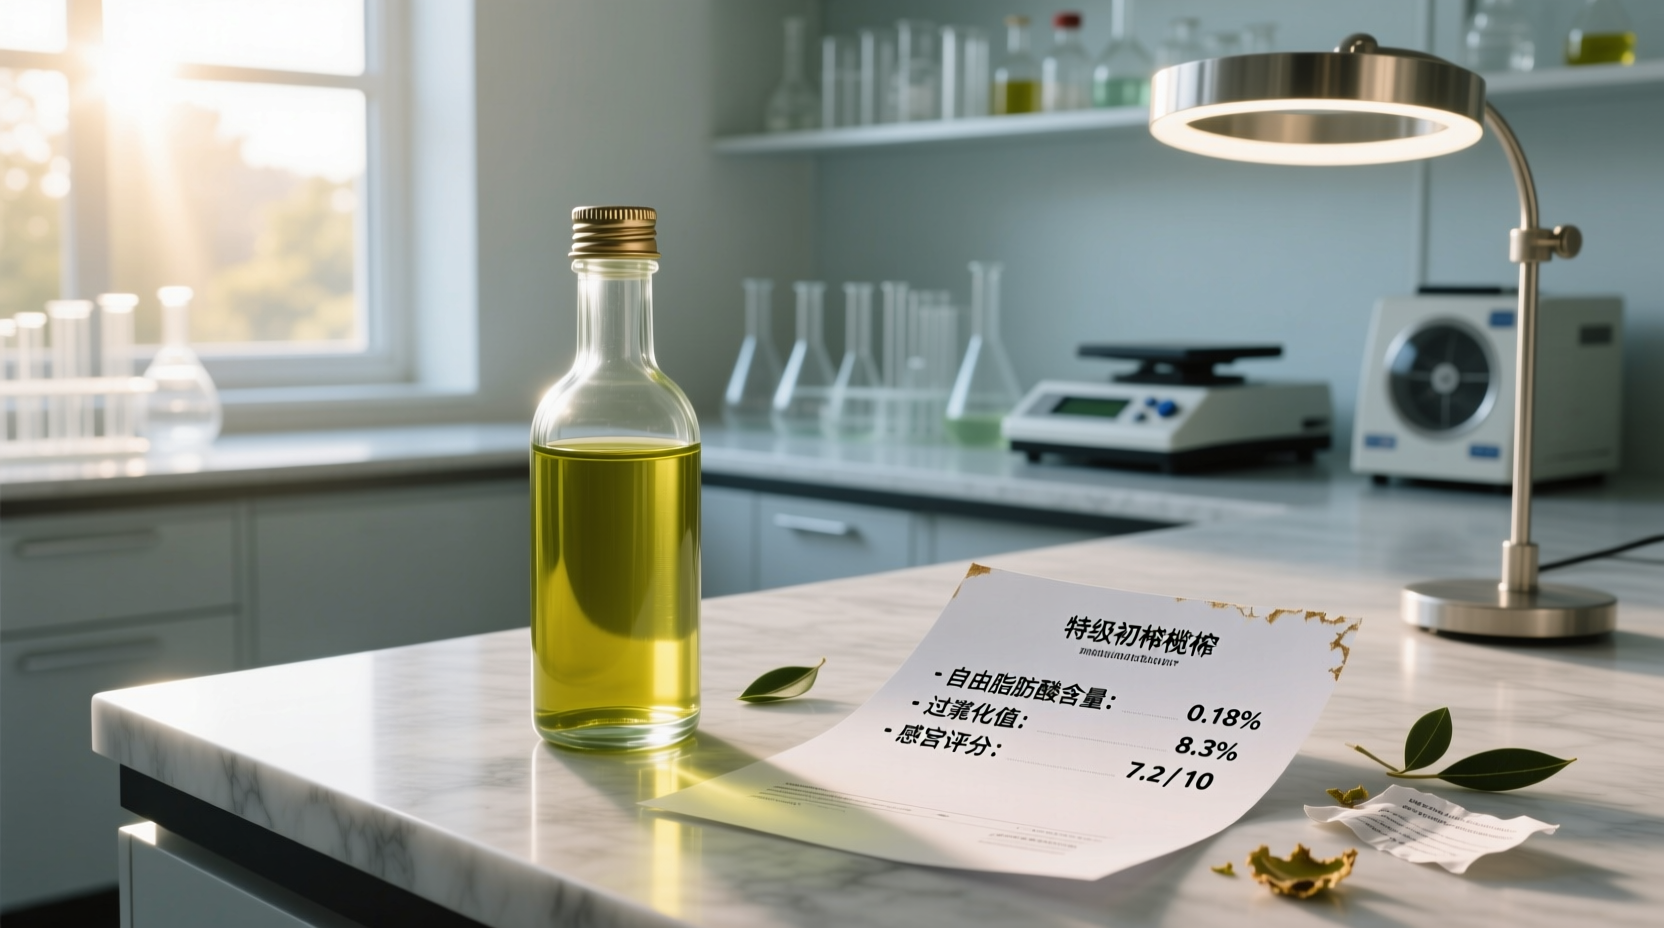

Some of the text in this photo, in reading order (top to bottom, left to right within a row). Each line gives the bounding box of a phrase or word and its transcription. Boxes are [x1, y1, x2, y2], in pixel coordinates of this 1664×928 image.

[1186, 704, 1262, 731] 0.18%
[1175, 736, 1238, 762] 8.3%
[1126, 761, 1214, 790] 7.2/10
